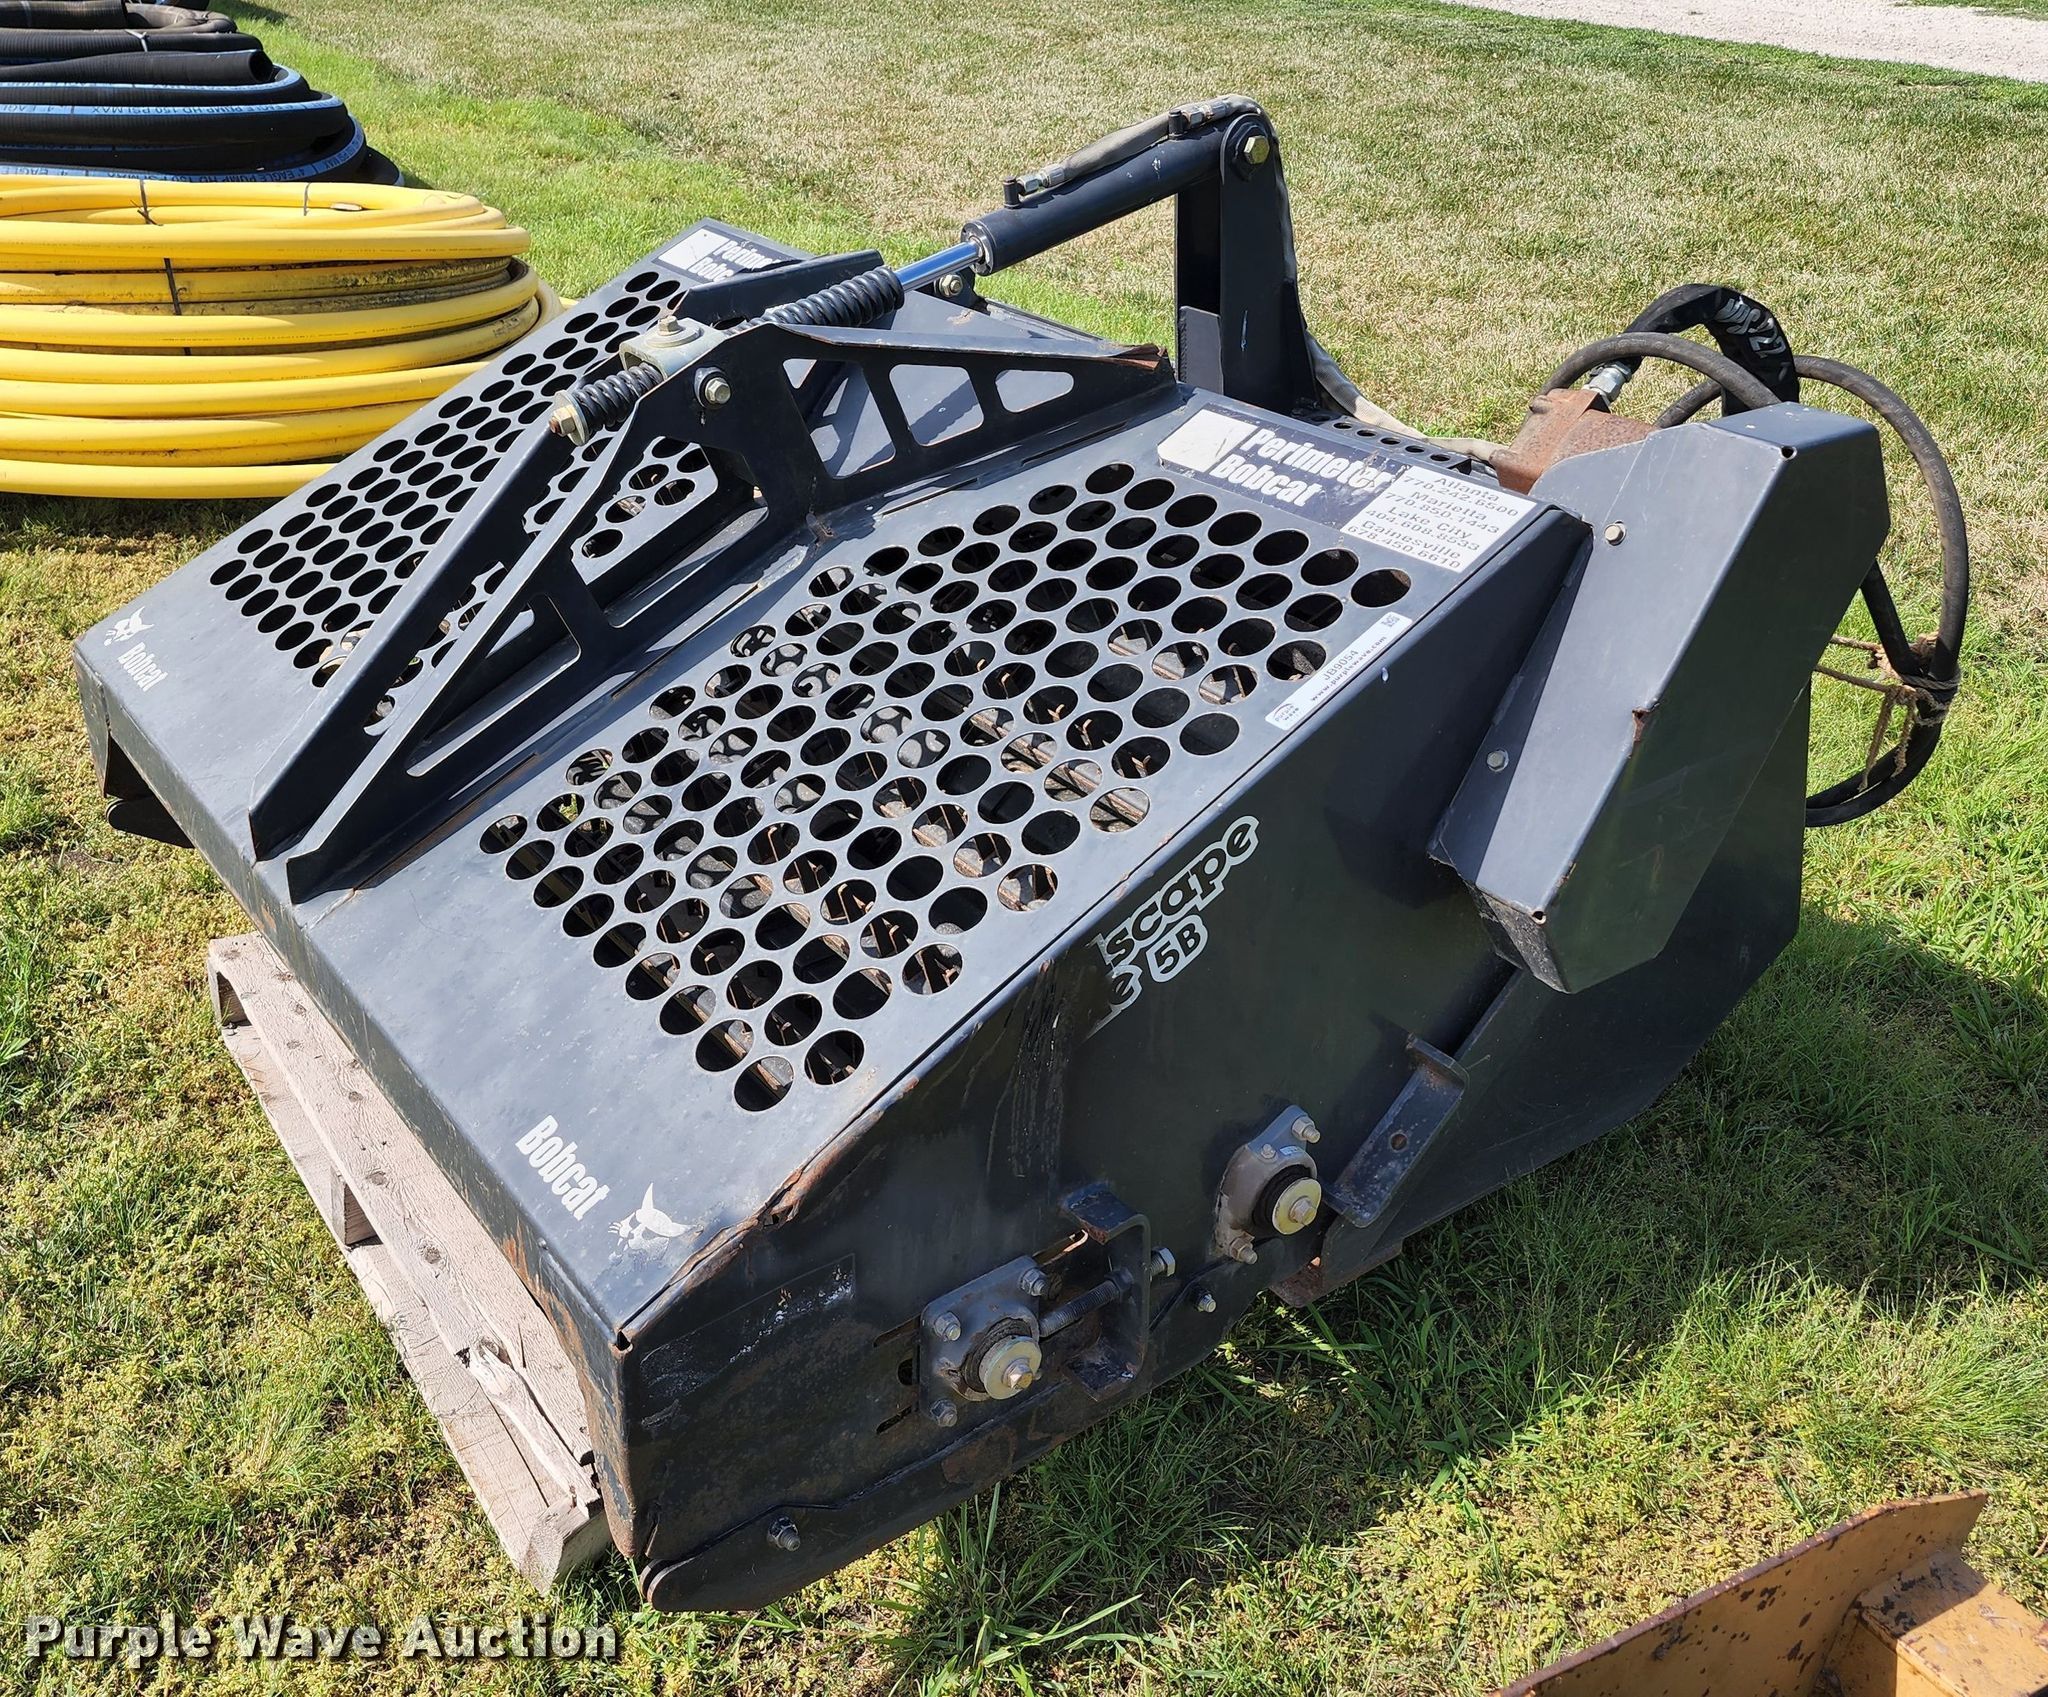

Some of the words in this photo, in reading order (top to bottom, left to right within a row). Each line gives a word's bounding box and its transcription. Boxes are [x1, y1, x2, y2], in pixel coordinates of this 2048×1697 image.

[0, 104, 38, 113] EAGL
[92, 106, 123, 114] MAX
[183, 107, 202, 115] HD
[208, 106, 243, 114] PUMP
[222, 173, 258, 182] PUMP
[259, 170, 296, 182] EAGLE
[690, 257, 735, 283] Bobc
[713, 240, 782, 270] Perime
[1239, 428, 1397, 492] Perimeter
[1209, 454, 1323, 507] Bobcat
[1402, 475, 1519, 518] 770.242.6500
[1434, 476, 1500, 502] Atlanta
[1411, 491, 1487, 521] Marietta
[1365, 509, 1481, 552] 404.608.8533
[1387, 506, 1432, 526] Lake
[1436, 521, 1473, 539] City
[1347, 526, 1462, 569] 678.450.6610
[1362, 520, 1461, 560] Gainesville
[117, 641, 169, 693] Bobcat
[1311, 635, 1388, 701] www.purplewave.com
[1324, 649, 1360, 681] JB9054
[1086, 815, 1260, 966] scape
[515, 1114, 611, 1222] Bobcat
